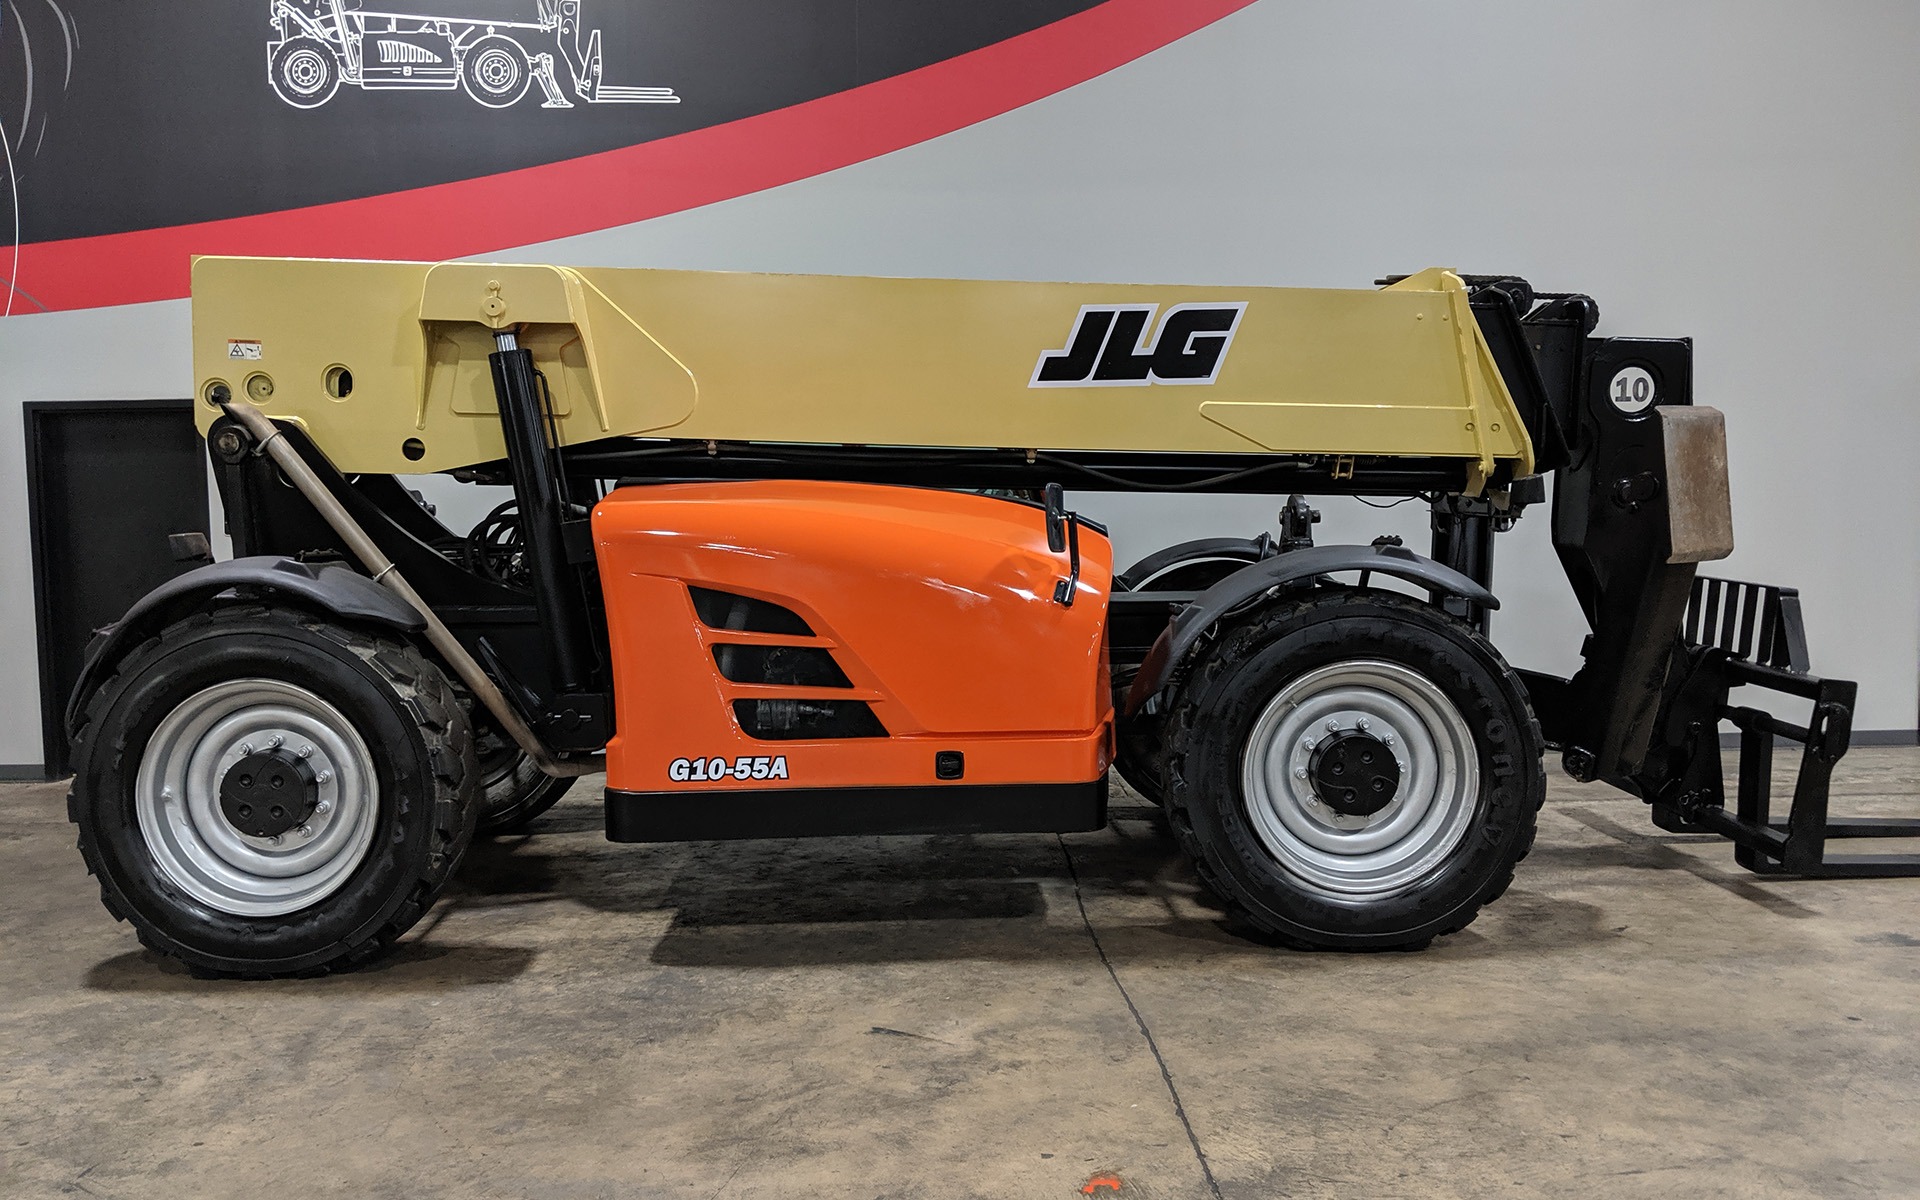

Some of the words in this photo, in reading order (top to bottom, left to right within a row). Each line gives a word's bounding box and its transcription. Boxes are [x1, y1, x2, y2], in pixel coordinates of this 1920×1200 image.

[1037, 309, 1239, 381] JLG
[1615, 377, 1650, 402] 10
[667, 755, 790, 782] G10-55A
